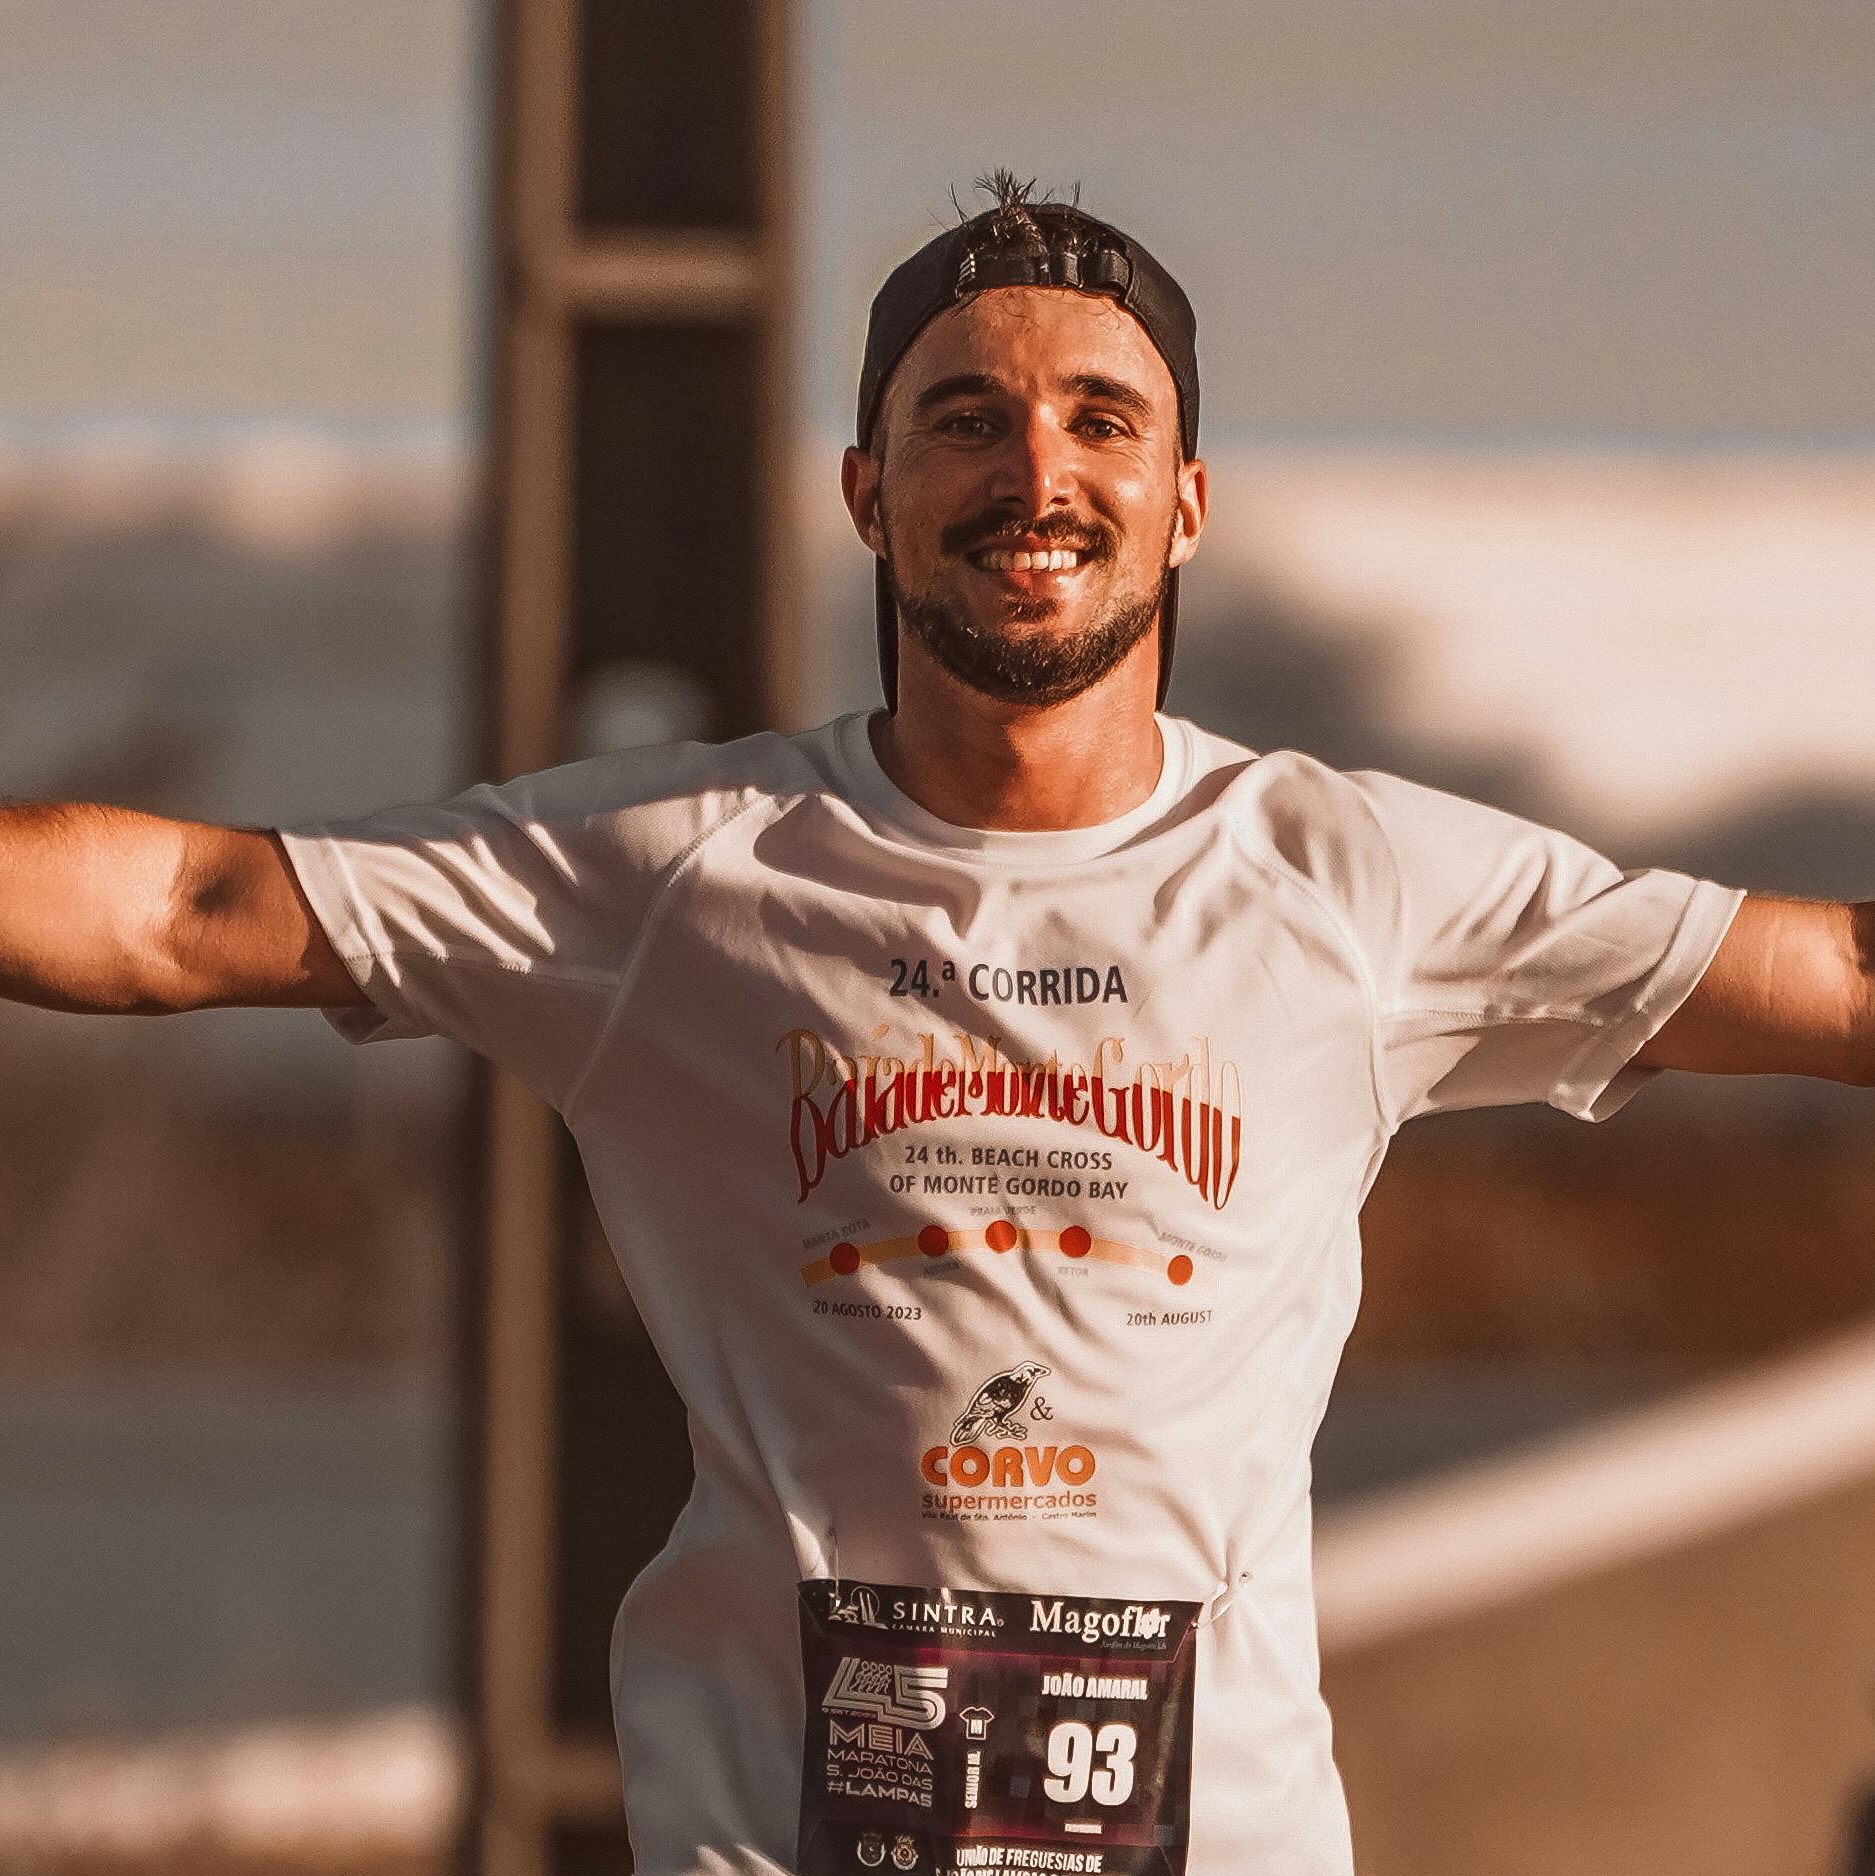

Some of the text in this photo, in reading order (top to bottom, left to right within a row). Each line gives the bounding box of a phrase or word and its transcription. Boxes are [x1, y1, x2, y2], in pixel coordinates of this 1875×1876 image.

[968, 963, 1129, 1005] CORRIDA
[904, 1146, 1113, 1171] 24 th. BEACH CROSS
[889, 1173, 1129, 1200] OF MONTE GORDO BAY
[812, 1300, 922, 1321] 20 AGOSTO 2023
[1127, 1309, 1212, 1326] 20th AUGUST
[1029, 1396, 1054, 1421] &
[920, 1445, 1096, 1488] CORVO
[922, 1490, 1097, 1514] supermercados
[892, 1601, 996, 1627] SINTRA
[1041, 1672, 1148, 1700] JOÃO AMARAL
[829, 1719, 934, 1761] MEIA
[827, 1748, 933, 1775] MARATONA
[1043, 1722, 1138, 1806] 93
[826, 1764, 933, 1791] S. JOÃO DAS
[826, 1780, 933, 1808] #LAMPAS
[988, 1848, 1005, 1866] DE
[1005, 1849, 1084, 1873] FREGUESIAS
[1085, 1854, 1104, 1874] DE
